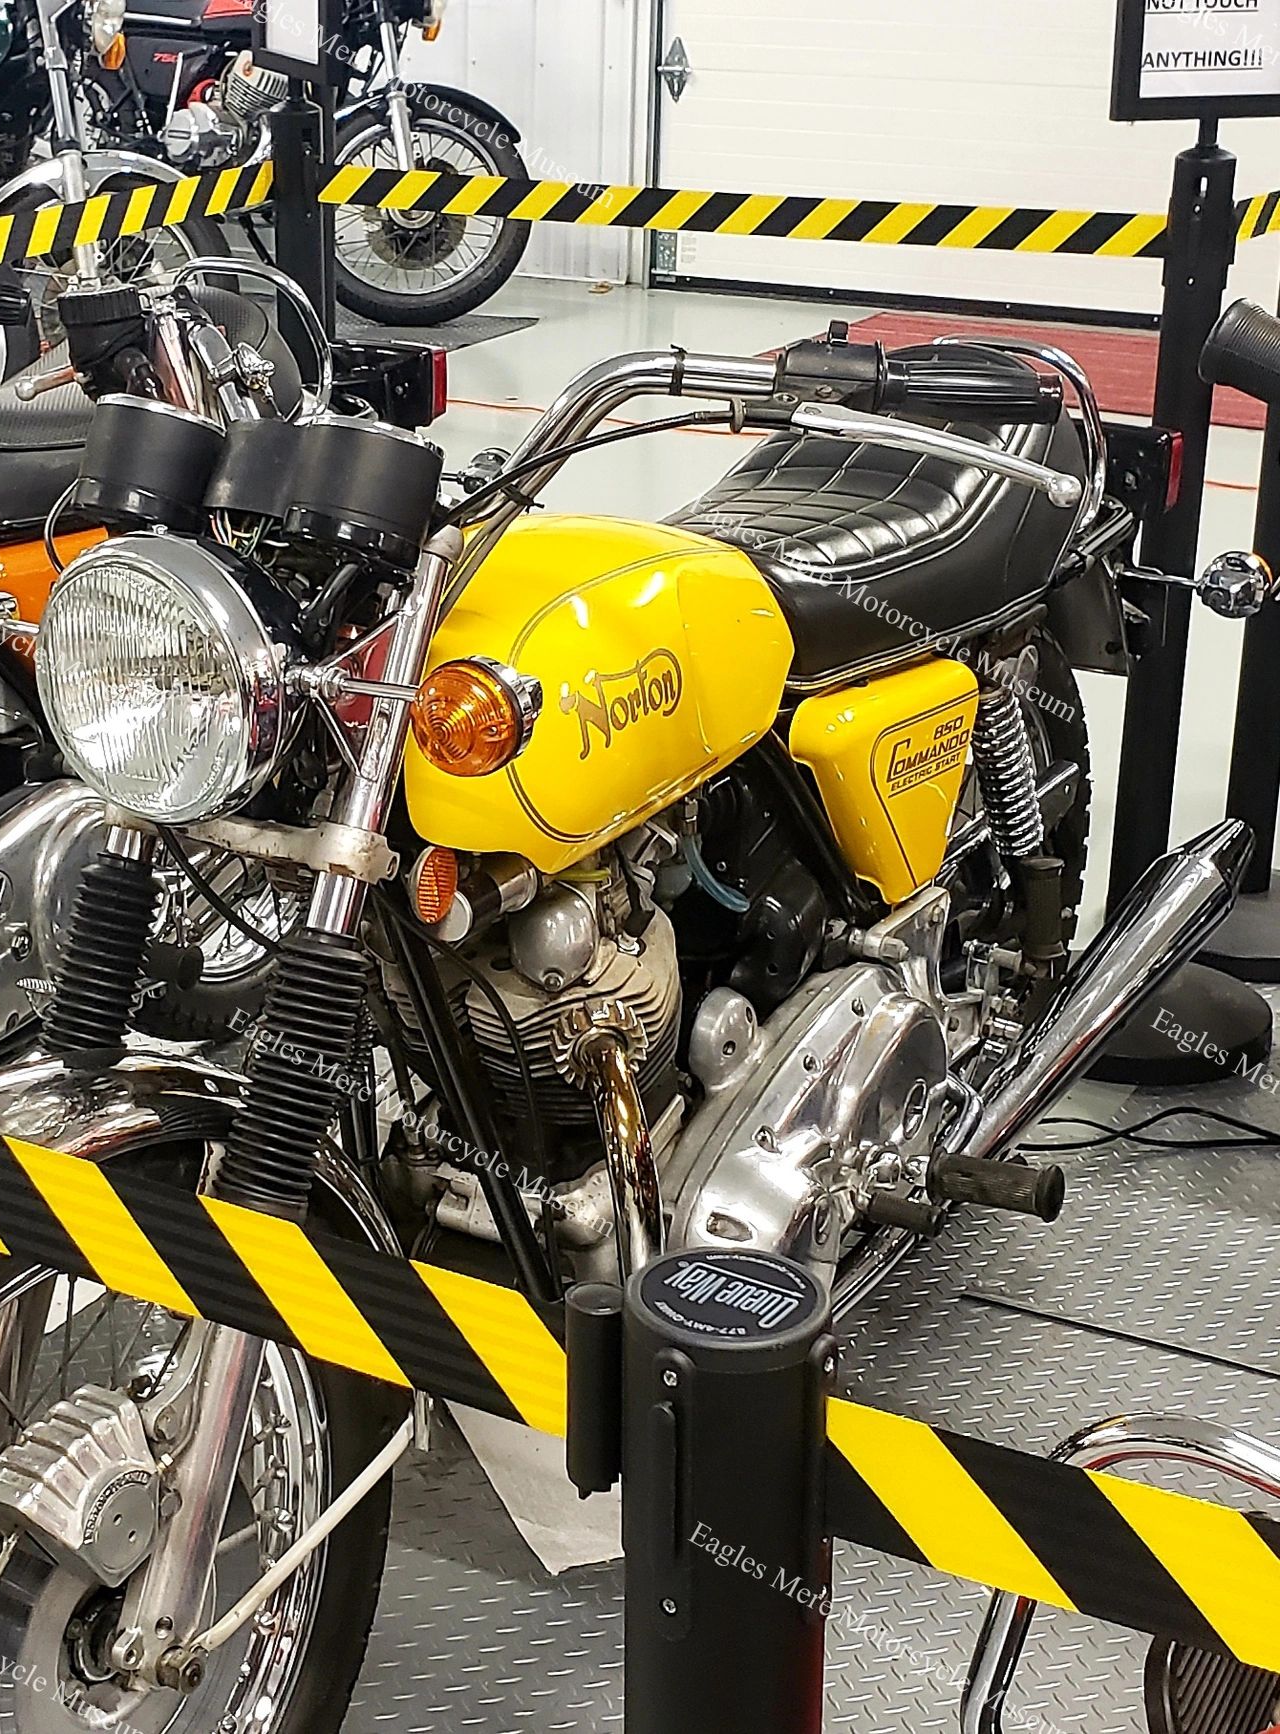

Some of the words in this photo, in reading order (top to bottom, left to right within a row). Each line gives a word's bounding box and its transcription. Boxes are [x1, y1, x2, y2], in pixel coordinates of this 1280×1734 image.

[1142, 49, 1262, 68] ANYTHING!!!
[559, 648, 682, 760] Norton
[933, 715, 964, 741] 850
[886, 728, 970, 784] COMMANDO
[891, 767, 932, 792] ELECTRIC
[934, 752, 961, 774] START
